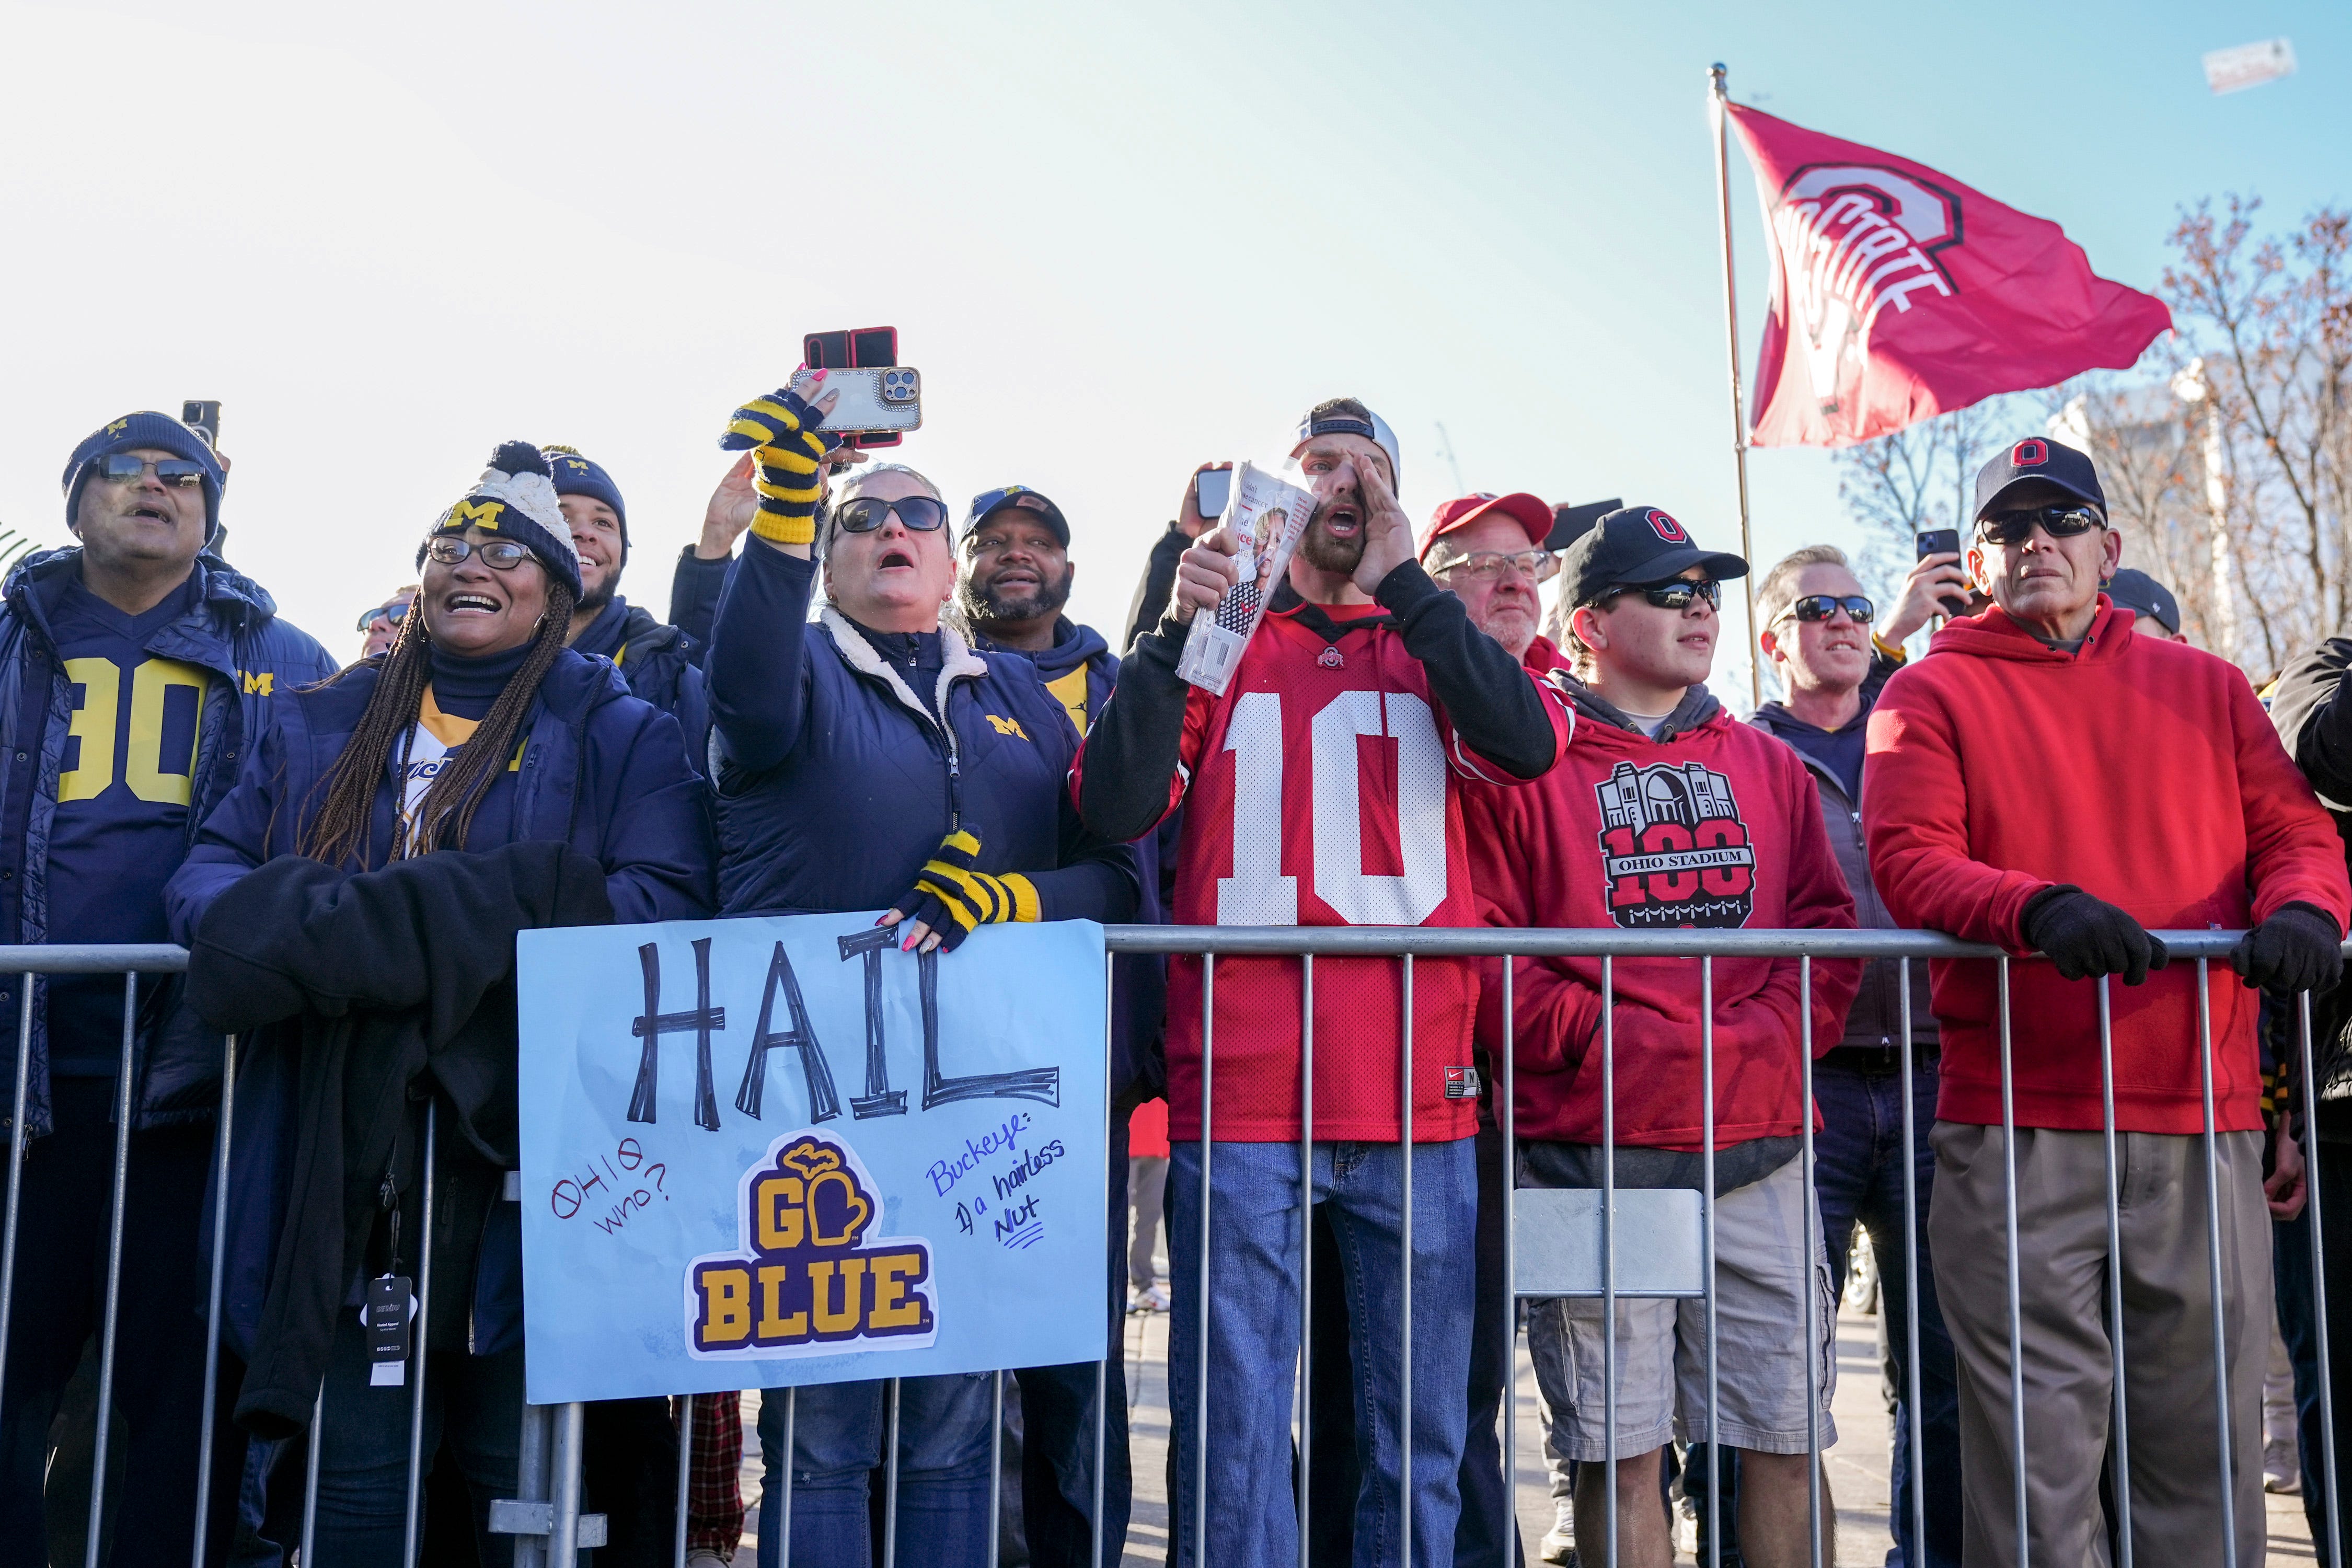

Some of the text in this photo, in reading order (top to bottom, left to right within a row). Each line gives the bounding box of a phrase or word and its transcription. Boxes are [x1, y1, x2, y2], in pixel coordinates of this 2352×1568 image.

[107, 418, 128, 435] M
[567, 459, 589, 470] M
[2011, 439, 2048, 468] O
[444, 500, 505, 530] M
[1248, 495, 1269, 509] cancer
[1644, 508, 1688, 544] O
[237, 670, 274, 697] M
[985, 715, 1030, 742] M
[1217, 690, 1447, 926] 10
[1605, 818, 1751, 907] 100
[1619, 851, 1744, 871] OHIO STADIUM
[627, 924, 1060, 1131] HAIL
[974, 1196, 987, 1215] a
[702, 1253, 920, 1343] BLUE
